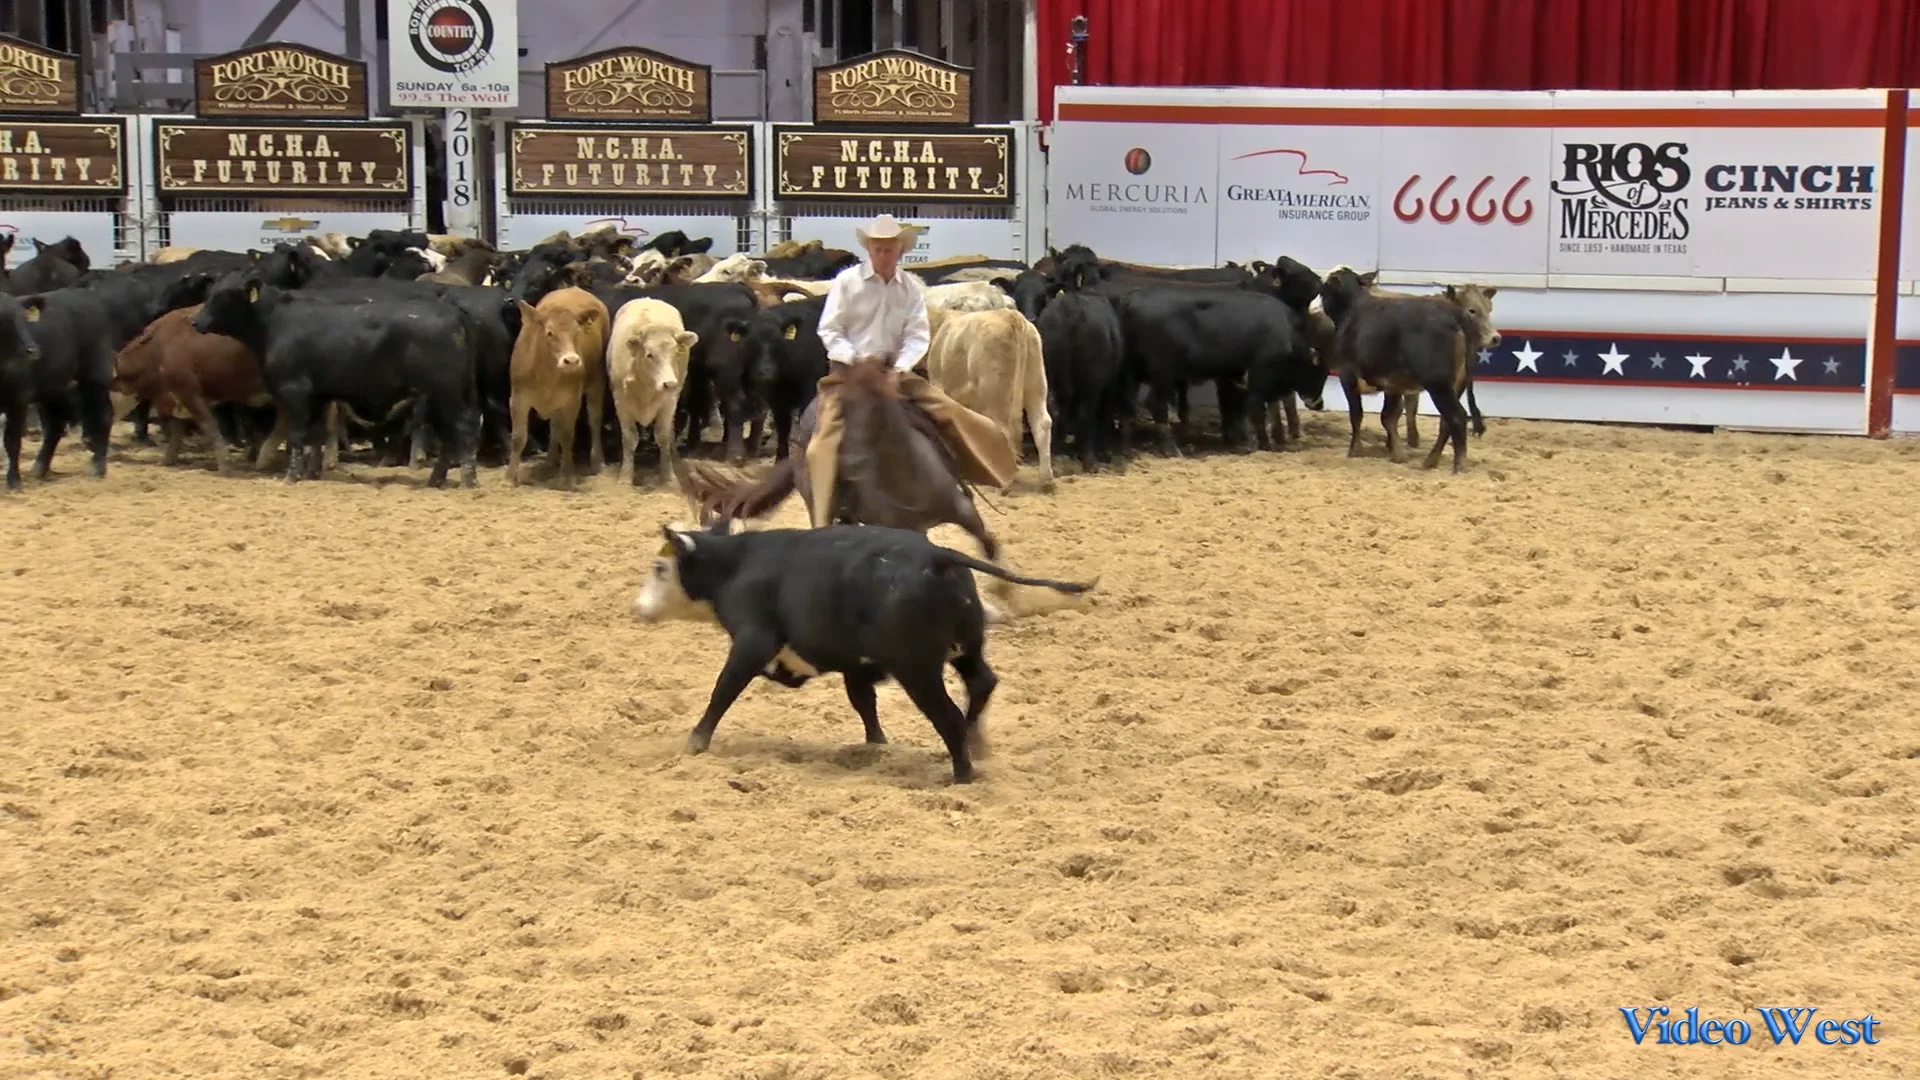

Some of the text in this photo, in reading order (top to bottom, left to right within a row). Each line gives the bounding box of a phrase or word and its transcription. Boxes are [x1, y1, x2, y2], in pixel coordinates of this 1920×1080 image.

[427, 25, 475, 39] COUNTRY
[0, 44, 62, 82] ORTH
[211, 50, 351, 89] FORT WORTH
[453, 58, 476, 72] TOP
[563, 55, 696, 94] FORT WORTH
[396, 81, 454, 92] SUNDAY
[461, 83, 477, 92] 6a
[828, 57, 958, 96] FORT WORTH
[398, 93, 508, 103] 99.5 The Wolf
[0, 130, 51, 154] H.A.
[228, 133, 340, 157] N.C.H.A.
[577, 137, 683, 160] N.C.H.A.
[841, 140, 944, 163] N.C.H.A.
[3, 157, 91, 181] RITY
[453, 110, 470, 207] 2018
[193, 159, 376, 184] FUTURITY
[542, 164, 717, 187] FUTURITY
[811, 166, 983, 190] FUTURITY
[1556, 142, 1691, 200] RIOS
[1704, 164, 1875, 193] CINCH
[1066, 182, 1208, 204] MERCURIA
[1393, 174, 1534, 226] 6666
[1627, 181, 1648, 206] of
[1704, 197, 1872, 212] JEANS & SHIRTS
[1149, 206, 1188, 214] SOLUTIONS
[1278, 209, 1370, 221] INSURANCE GROUP
[1560, 197, 1690, 241] MERCEDES
[261, 237, 303, 245] CHEVRO
[1560, 243, 1687, 254] SINCE 1853 HANDMADE IN TEXAS
[904, 255, 929, 264] TEXAS
